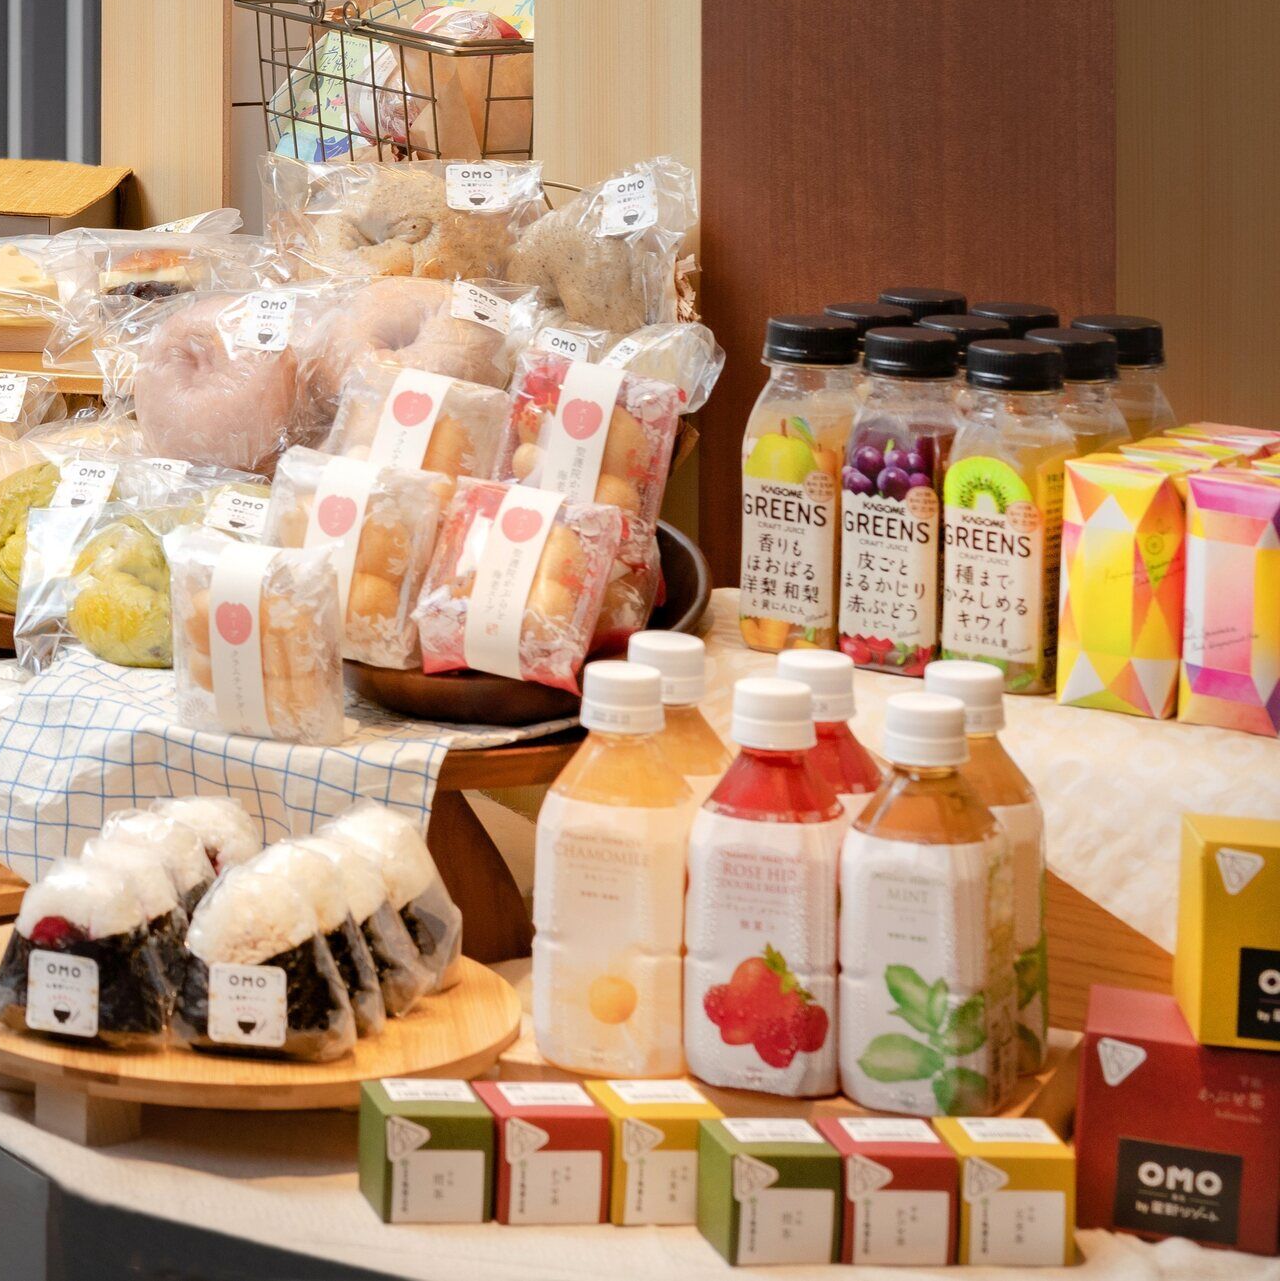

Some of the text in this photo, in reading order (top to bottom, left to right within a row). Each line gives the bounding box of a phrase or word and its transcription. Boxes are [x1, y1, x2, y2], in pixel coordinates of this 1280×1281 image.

[461, 170, 492, 179] OMO
[617, 179, 645, 193] OMO
[260, 299, 287, 310] OMO
[469, 288, 498, 306] OMO
[551, 337, 577, 352] OMO
[79, 467, 106, 479] OMO
[761, 484, 803, 499] KAGOME
[232, 498, 264, 510] OMO
[744, 493, 827, 527] GREENS
[863, 501, 906, 516] KAGOME
[845, 510, 931, 544] GREENS
[961, 514, 1006, 528] KAGOME
[760, 533, 802, 557] 香りも
[944, 523, 1031, 558] GREENS
[747, 555, 815, 581] ほおばる
[858, 551, 908, 576] 皮ごと
[845, 573, 926, 600] まるかじり
[956, 564, 1015, 590] 種まで
[847, 594, 918, 621] 赤ぶどう
[945, 588, 1028, 616] かみしめる
[957, 610, 1006, 635] キウイ
[47, 963, 81, 978] OMO
[229, 975, 266, 988] OMO
[1138, 1161, 1223, 1197] OMO
